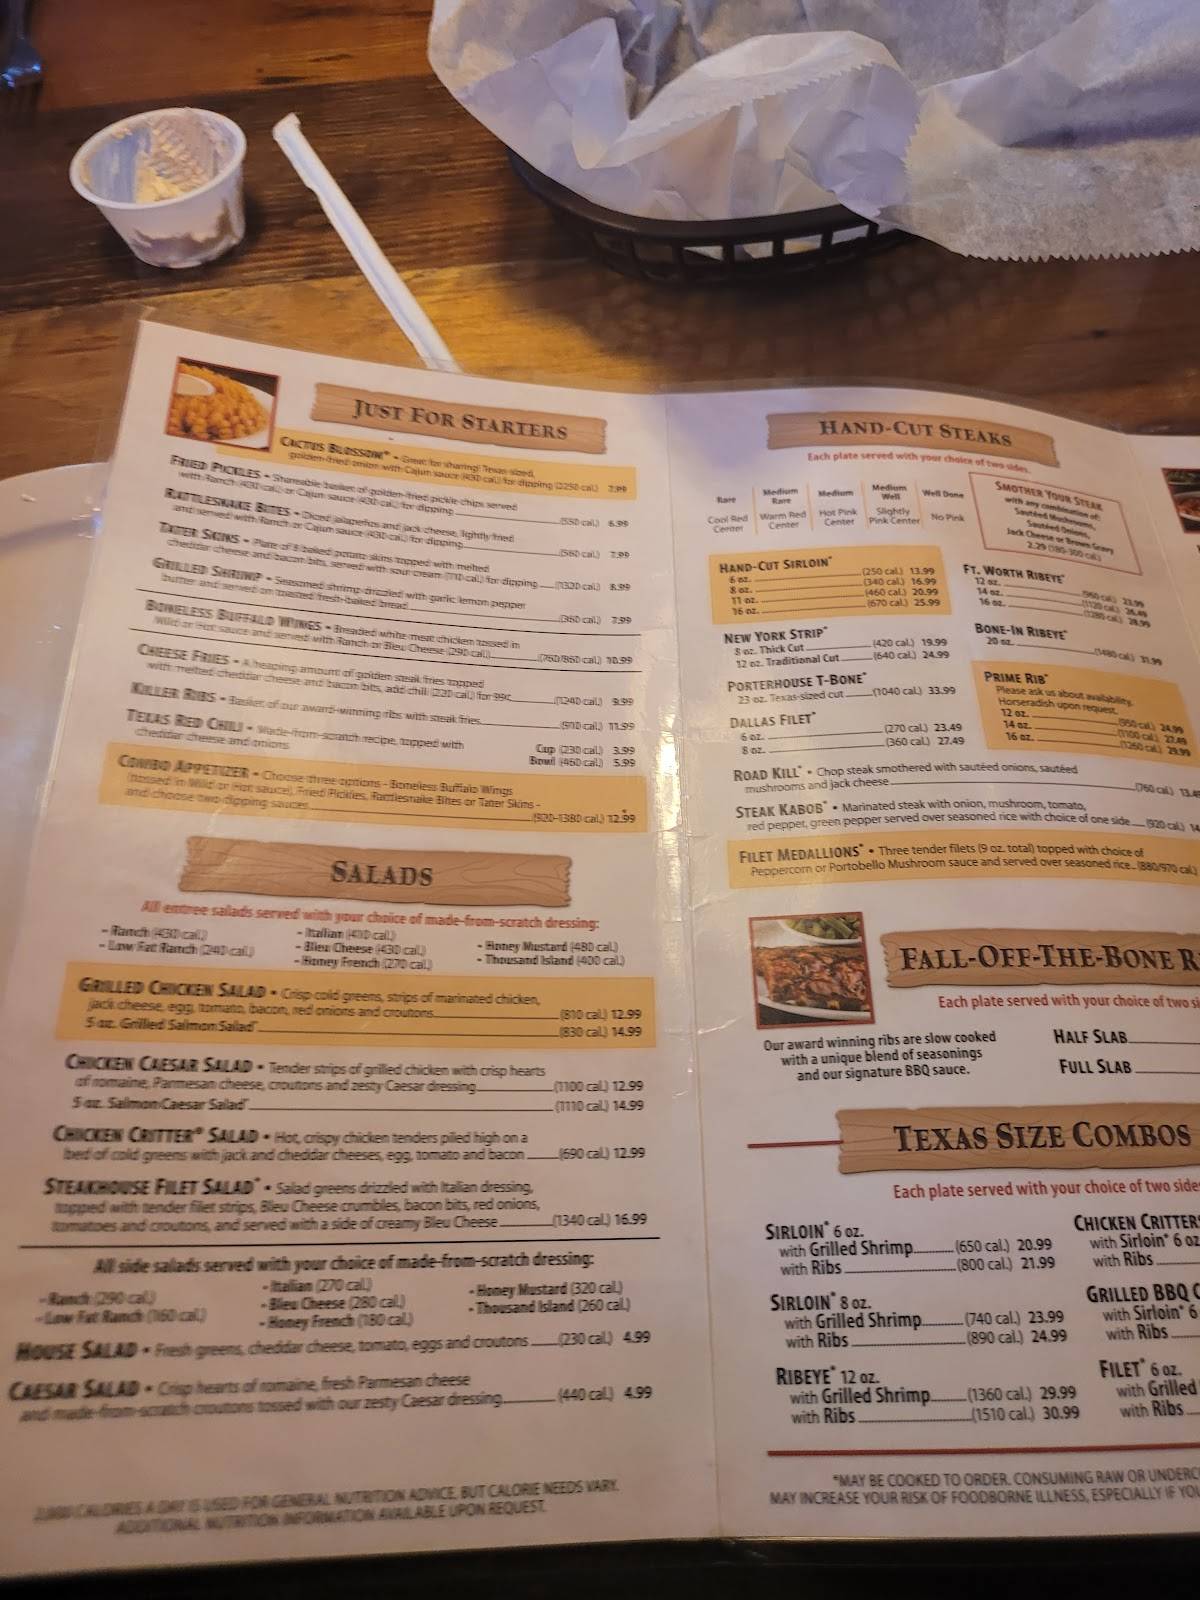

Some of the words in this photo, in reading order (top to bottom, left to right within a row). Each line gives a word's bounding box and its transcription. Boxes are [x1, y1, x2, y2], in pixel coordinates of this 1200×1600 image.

[352, 399, 403, 420] JUST
[411, 407, 453, 429] FOR
[462, 414, 568, 440] STARTERS
[819, 420, 933, 436] HAND-CUT
[940, 424, 1012, 448] STEAKS
[763, 488, 798, 496] Medium
[818, 489, 854, 497] Medium
[872, 484, 907, 492] Medium
[922, 489, 942, 497] Well
[995, 480, 1043, 497] SMOTHER
[1047, 490, 1071, 504] YOUR
[1074, 496, 1103, 511] STEAK
[882, 492, 900, 500] Well
[820, 509, 836, 517] Hot
[838, 508, 857, 516] Pink
[877, 507, 910, 516] Slightly
[931, 513, 945, 521] No
[946, 513, 965, 521] Pink
[824, 517, 854, 526] Center
[869, 517, 889, 525] Pink
[891, 517, 920, 525] Center
[963, 564, 980, 575] FT.
[983, 565, 1023, 579] WORTH
[724, 633, 751, 643] NEW
[755, 631, 786, 642] YORK
[975, 623, 1023, 636] BONE-IN
[984, 672, 1020, 682] PRIME
[728, 678, 813, 692] PORTERHOUSE
[730, 716, 775, 728] DALLAS
[734, 770, 768, 781] ROAD
[817, 767, 844, 778] Chop
[848, 764, 874, 775] steak
[876, 763, 932, 774] smothered
[934, 762, 957, 772] with
[959, 763, 999, 772] sautéed
[1001, 764, 1037, 773] onions,
[1040, 765, 1078, 774] sautéed
[739, 851, 773, 863] FILET
[330, 860, 433, 886] SALADS
[900, 944, 1174, 971] FALL-OFF-THE-BONE
[80, 977, 144, 993] GRILLED
[150, 980, 213, 996] CHICKEN
[219, 983, 266, 998] SALAD
[763, 1040, 784, 1051] Our
[787, 1038, 824, 1050] award
[827, 1036, 875, 1049] winning
[878, 1034, 900, 1045] ribs
[903, 1034, 922, 1045] are
[925, 1032, 950, 1043] slow
[954, 1031, 996, 1043] cooked
[1054, 1029, 1089, 1044] HALF
[1093, 1029, 1128, 1044] SLAB
[66, 1054, 134, 1071] CHICKEN
[139, 1056, 198, 1072] CAESAR
[203, 1057, 252, 1072] SALAD
[781, 1055, 808, 1066] with
[811, 1056, 818, 1064] a
[821, 1053, 862, 1065] unique
[865, 1051, 899, 1062] blend
[902, 1049, 913, 1060] of
[916, 1048, 983, 1061] seasonings
[797, 1070, 819, 1081] and
[823, 1069, 842, 1080] our
[845, 1066, 902, 1081] signature
[906, 1064, 930, 1077] BBQ
[933, 1064, 970, 1075] sauce.
[1059, 1059, 1093, 1074] FULL
[1097, 1059, 1131, 1073] SLAB
[893, 1126, 988, 1151] TEXAS
[996, 1123, 1065, 1149] SIZE
[1072, 1121, 1191, 1147] COMBOS
[559, 1148, 584, 1160] (690
[614, 1148, 646, 1159] 12.99
[893, 1184, 925, 1199] Each
[929, 1184, 963, 1200] plate
[968, 1182, 1013, 1196] served
[1016, 1182, 1047, 1195] with
[1051, 1182, 1081, 1197] your
[1084, 1179, 1127, 1193] choice
[1130, 1179, 1142, 1193] of
[1145, 1180, 1170, 1192] two
[1074, 1215, 1136, 1231] CHICKEN
[834, 1226, 842, 1237] 6
[845, 1227, 864, 1238] oz.
[779, 1245, 806, 1258] with
[810, 1242, 857, 1256] Grilled
[861, 1241, 913, 1258] Shrimp
[955, 1240, 982, 1253] (650
[1017, 1239, 1052, 1251] 20.99
[781, 1264, 808, 1276] with
[812, 1261, 842, 1274] Ribs
[957, 1259, 985, 1272] (800
[1021, 1257, 1055, 1269] 21.99
[1087, 1285, 1148, 1302] GRILLED
[1153, 1284, 1189, 1302] BBQ
[870, 1474, 884, 1487] BE
[888, 1473, 940, 1487] COOKED
[944, 1473, 961, 1486] TO
[964, 1473, 1010, 1486] ORDER.
[1014, 1471, 1093, 1486] CONSUMING
[1097, 1471, 1124, 1484] RAW
[1127, 1470, 1145, 1483] OR
